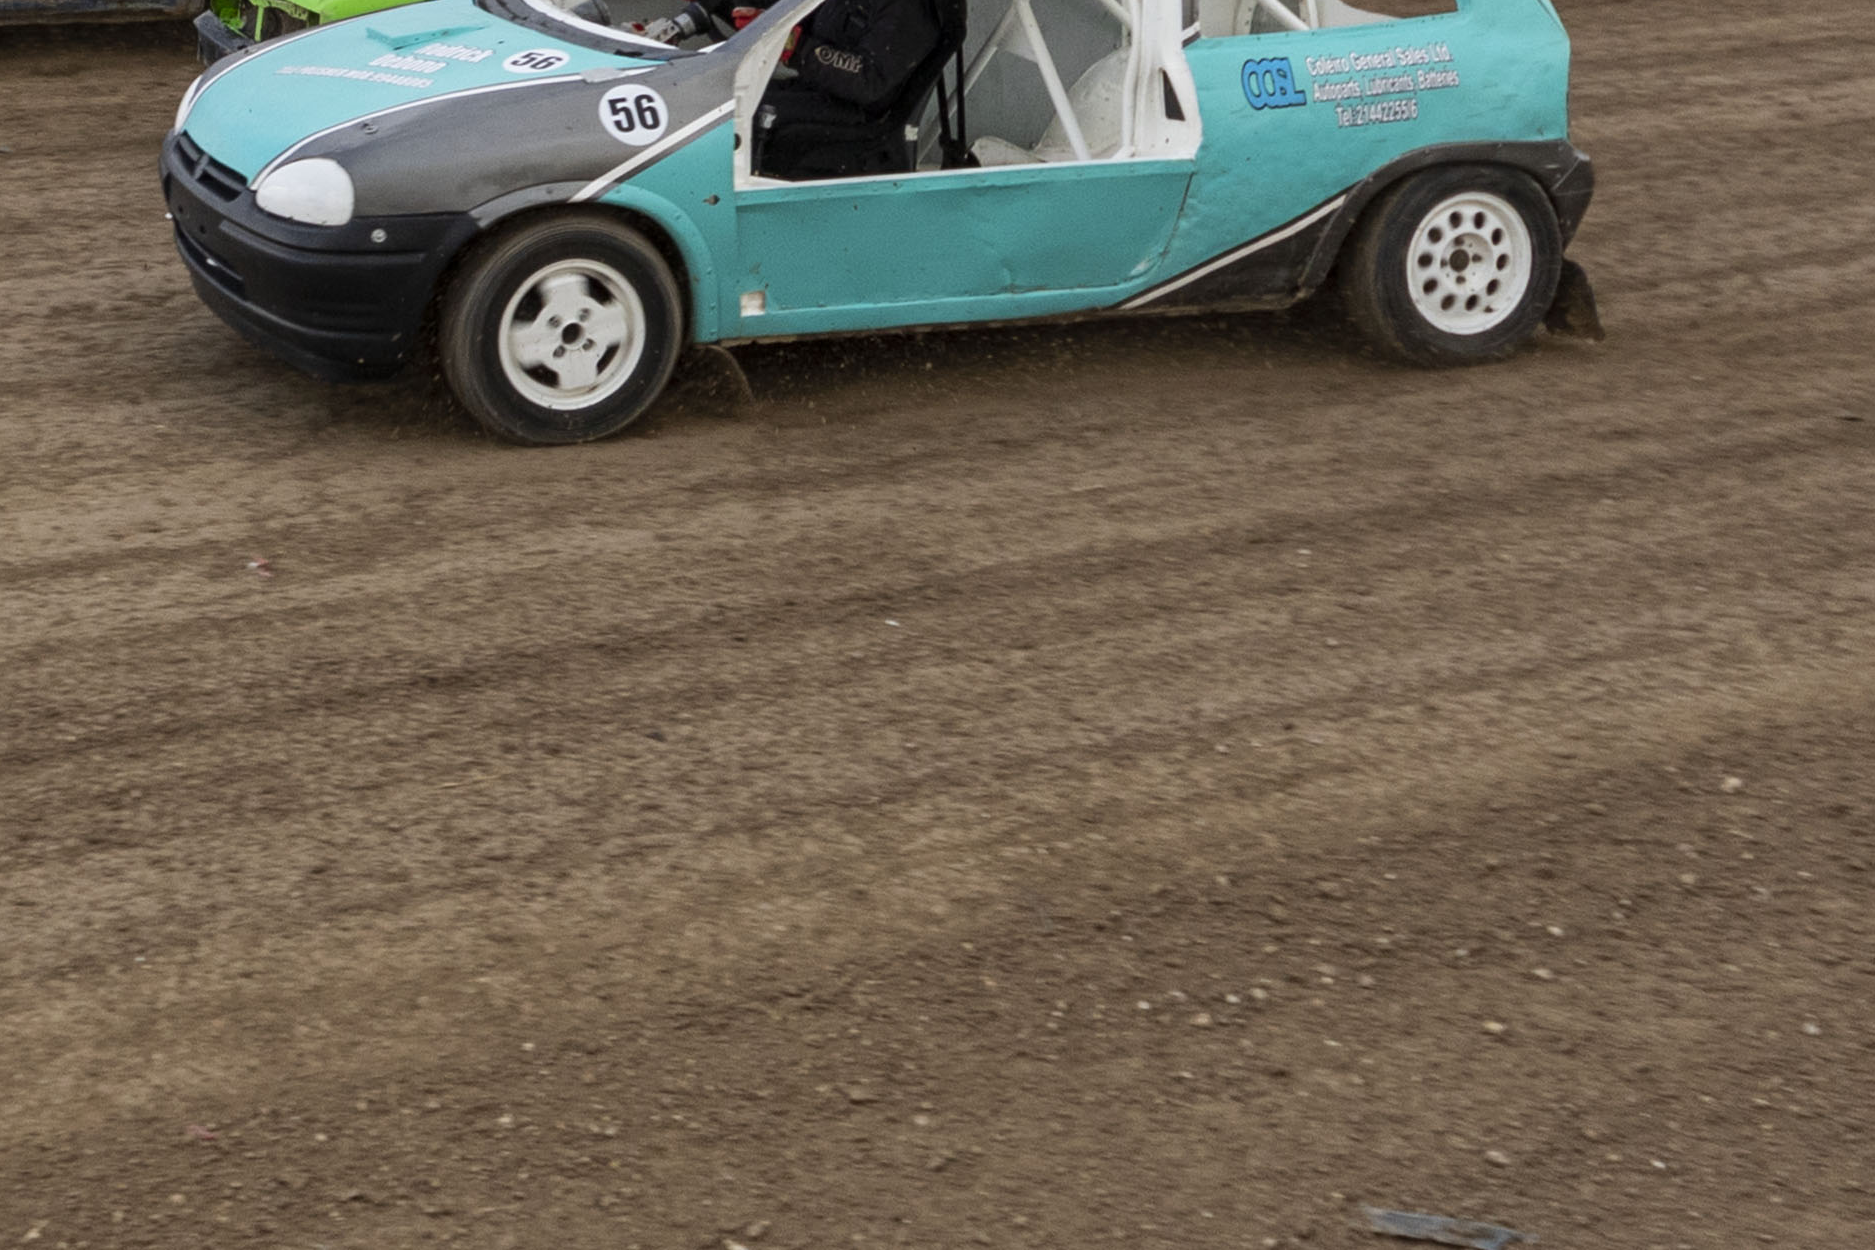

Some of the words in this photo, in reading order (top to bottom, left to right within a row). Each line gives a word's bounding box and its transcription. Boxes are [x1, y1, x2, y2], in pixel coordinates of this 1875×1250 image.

[511, 52, 563, 70] 56
[1349, 50, 1396, 71] General
[1394, 44, 1430, 67] Sales
[608, 94, 660, 133] 56
